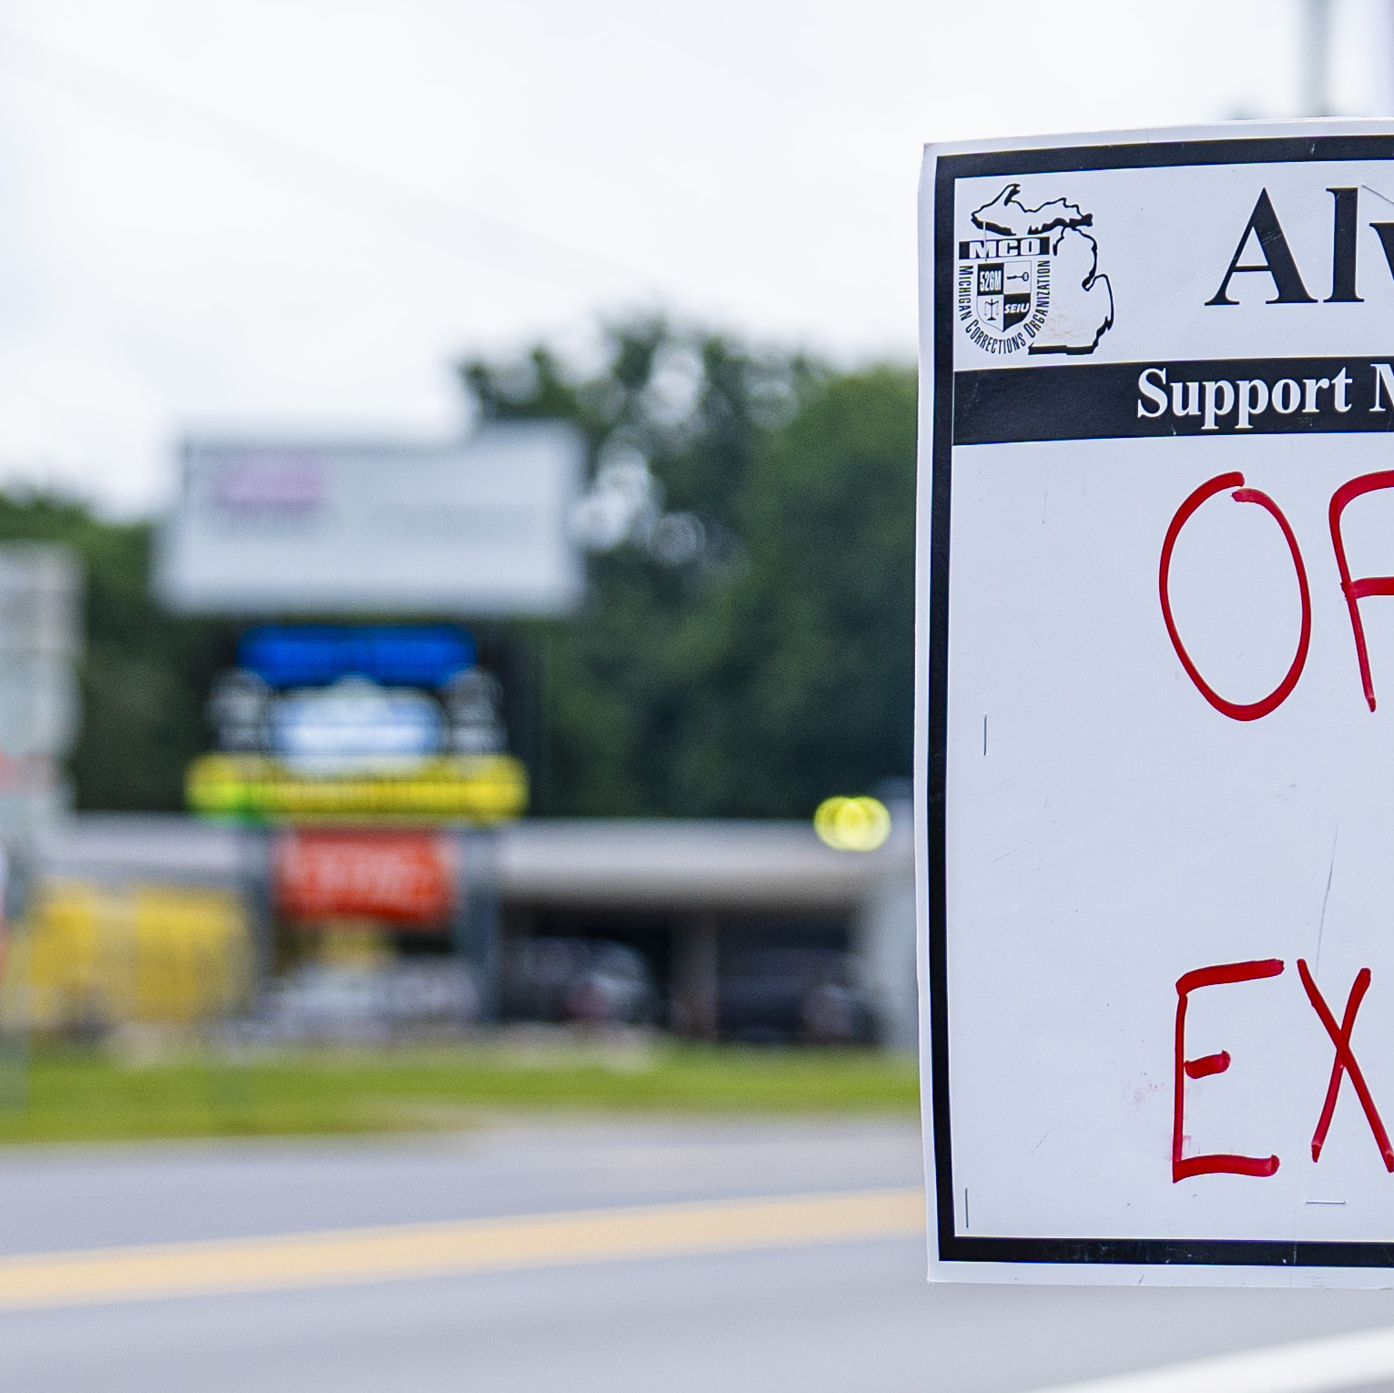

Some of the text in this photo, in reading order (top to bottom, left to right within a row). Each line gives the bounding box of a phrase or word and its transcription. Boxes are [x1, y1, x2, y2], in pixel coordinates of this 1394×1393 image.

[968, 238, 1041, 259] MCO
[958, 260, 1051, 355] MICHIGAN CORRECTIONS ORGANIZATION
[1004, 302, 1030, 314] SEIU
[1137, 366, 1353, 430] Support
